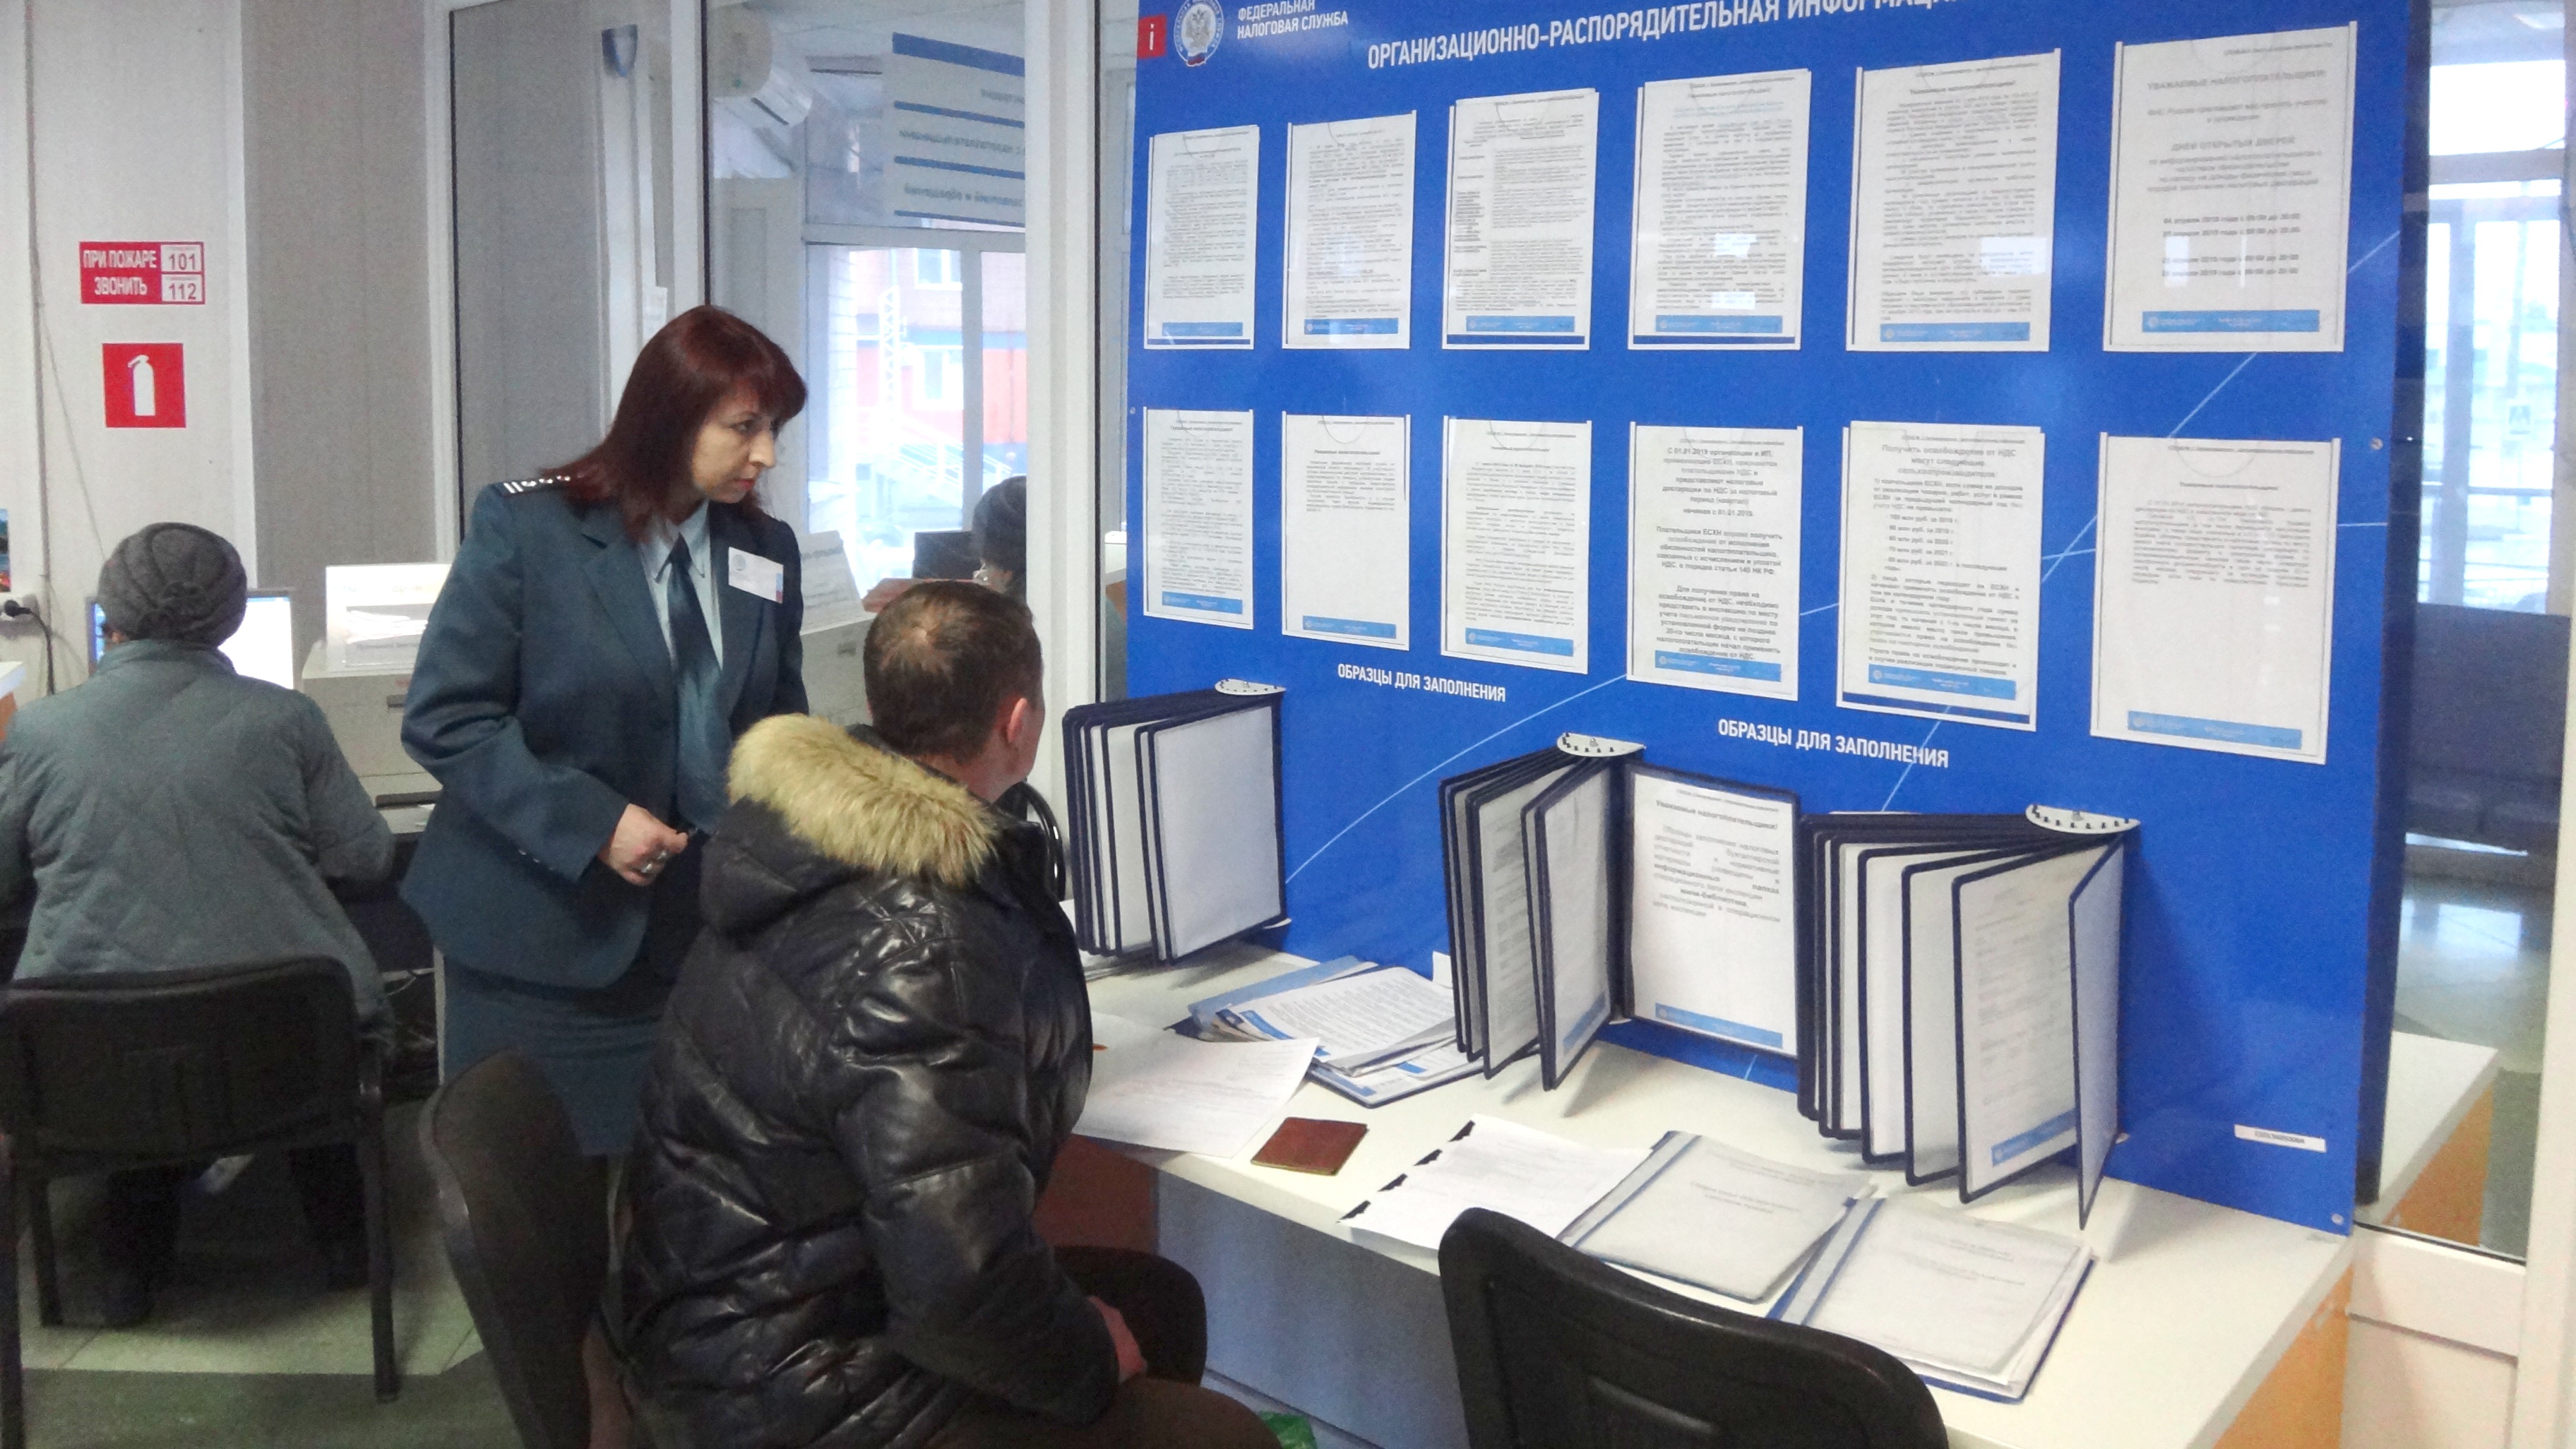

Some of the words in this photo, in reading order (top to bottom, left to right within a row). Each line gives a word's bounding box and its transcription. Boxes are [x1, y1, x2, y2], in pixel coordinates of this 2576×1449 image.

[1238, 0, 1315, 21] ФЕДЕРАЛЬНАЯ
[1237, 18, 1299, 40] НАЛОГОВАЯ
[1301, 11, 1348, 31] СЛУЖБА
[1368, 0, 1779, 68] ОРГАНИЗАЦИОННО-РАСПОРЯДИТЕЛЬНАЯ
[83, 249, 107, 268] ПРИ
[109, 249, 157, 268] ПОЖАРЕ
[169, 254, 196, 270] 101
[94, 276, 148, 295] ЗВОНИТЬ
[169, 282, 196, 300] 112
[1337, 663, 1392, 686] ОБРАЗЦЫ
[1395, 672, 1421, 689] ДЛЯ
[1423, 676, 1506, 703] ЗАПОЛНЕНИЯ
[1717, 718, 1792, 746] ОБРАЗЦЫ
[1796, 729, 1831, 751] ДЛЯ
[1835, 735, 1949, 768] ЗАПОЛНЕНИЯ
